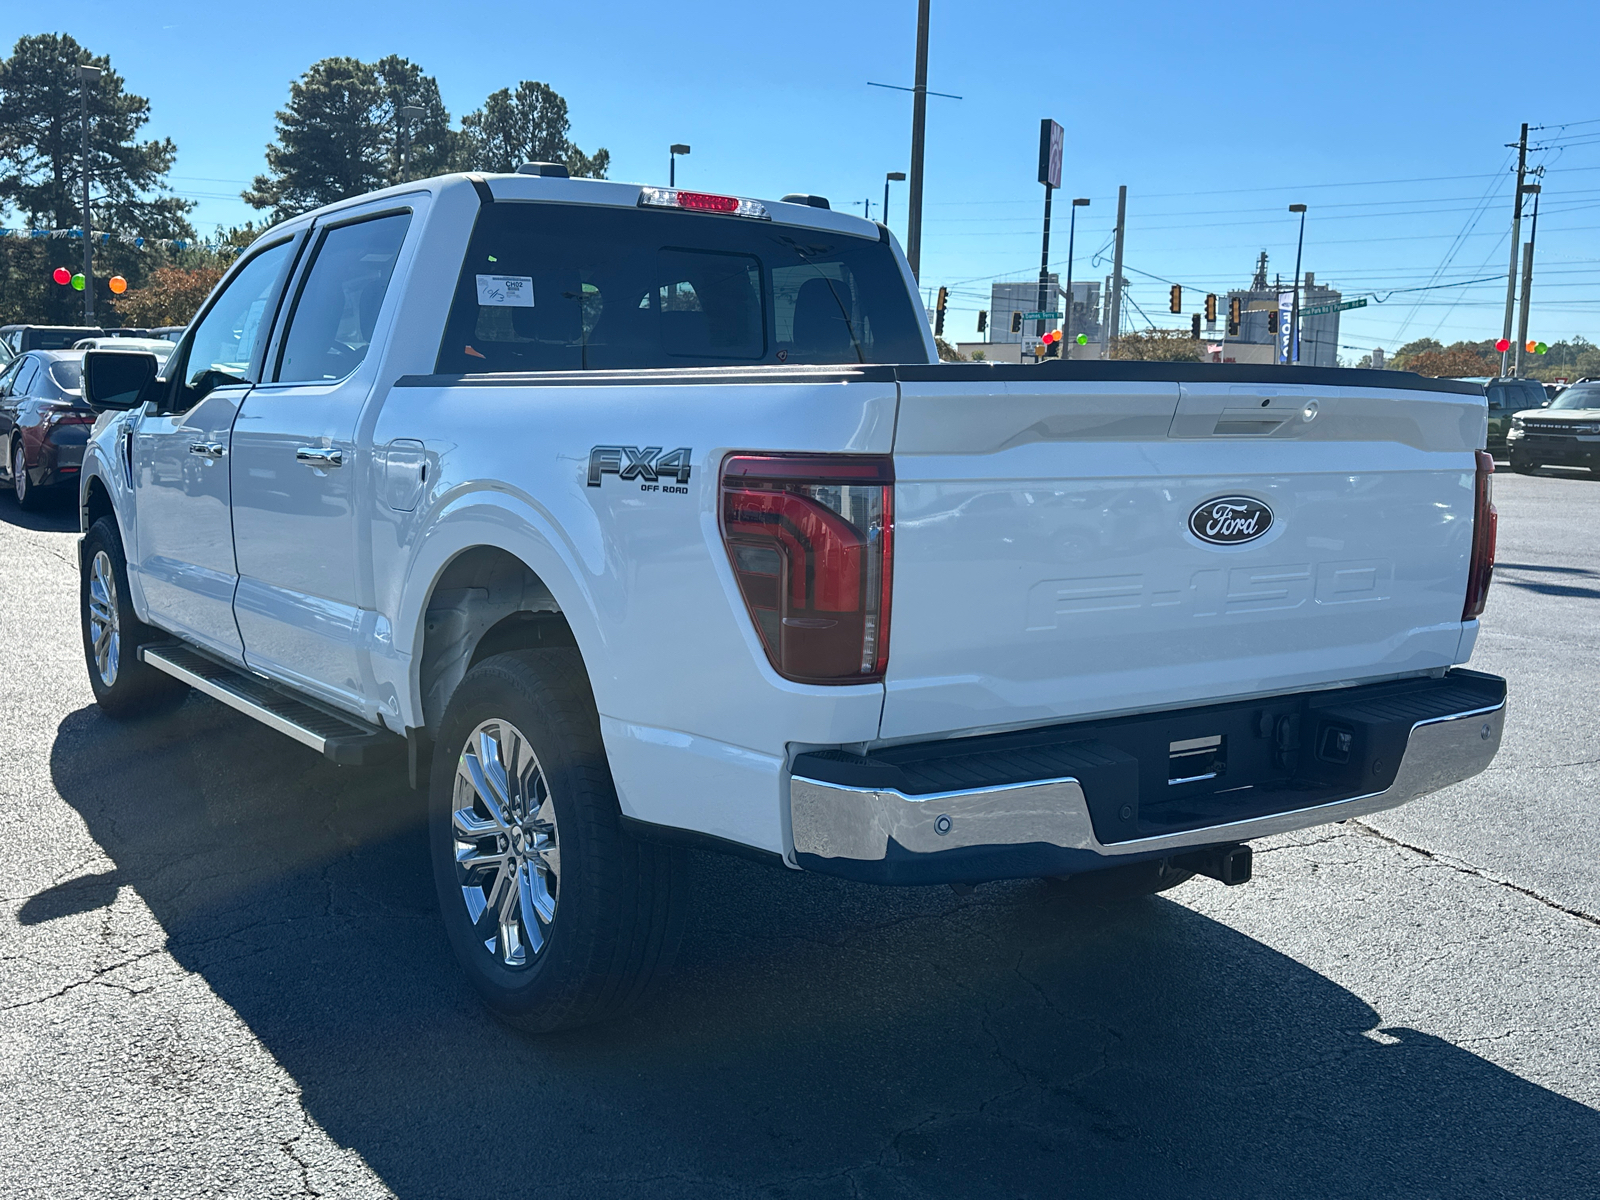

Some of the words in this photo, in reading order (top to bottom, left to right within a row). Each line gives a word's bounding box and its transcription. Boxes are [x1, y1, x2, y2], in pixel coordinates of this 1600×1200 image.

[1311, 307, 1321, 315] Park
[587, 445, 692, 488] FX4
[641, 484, 659, 492] OFF
[662, 485, 689, 495] ROAD
[1206, 503, 1260, 536] Ford
[1026, 557, 1395, 632] F-150
